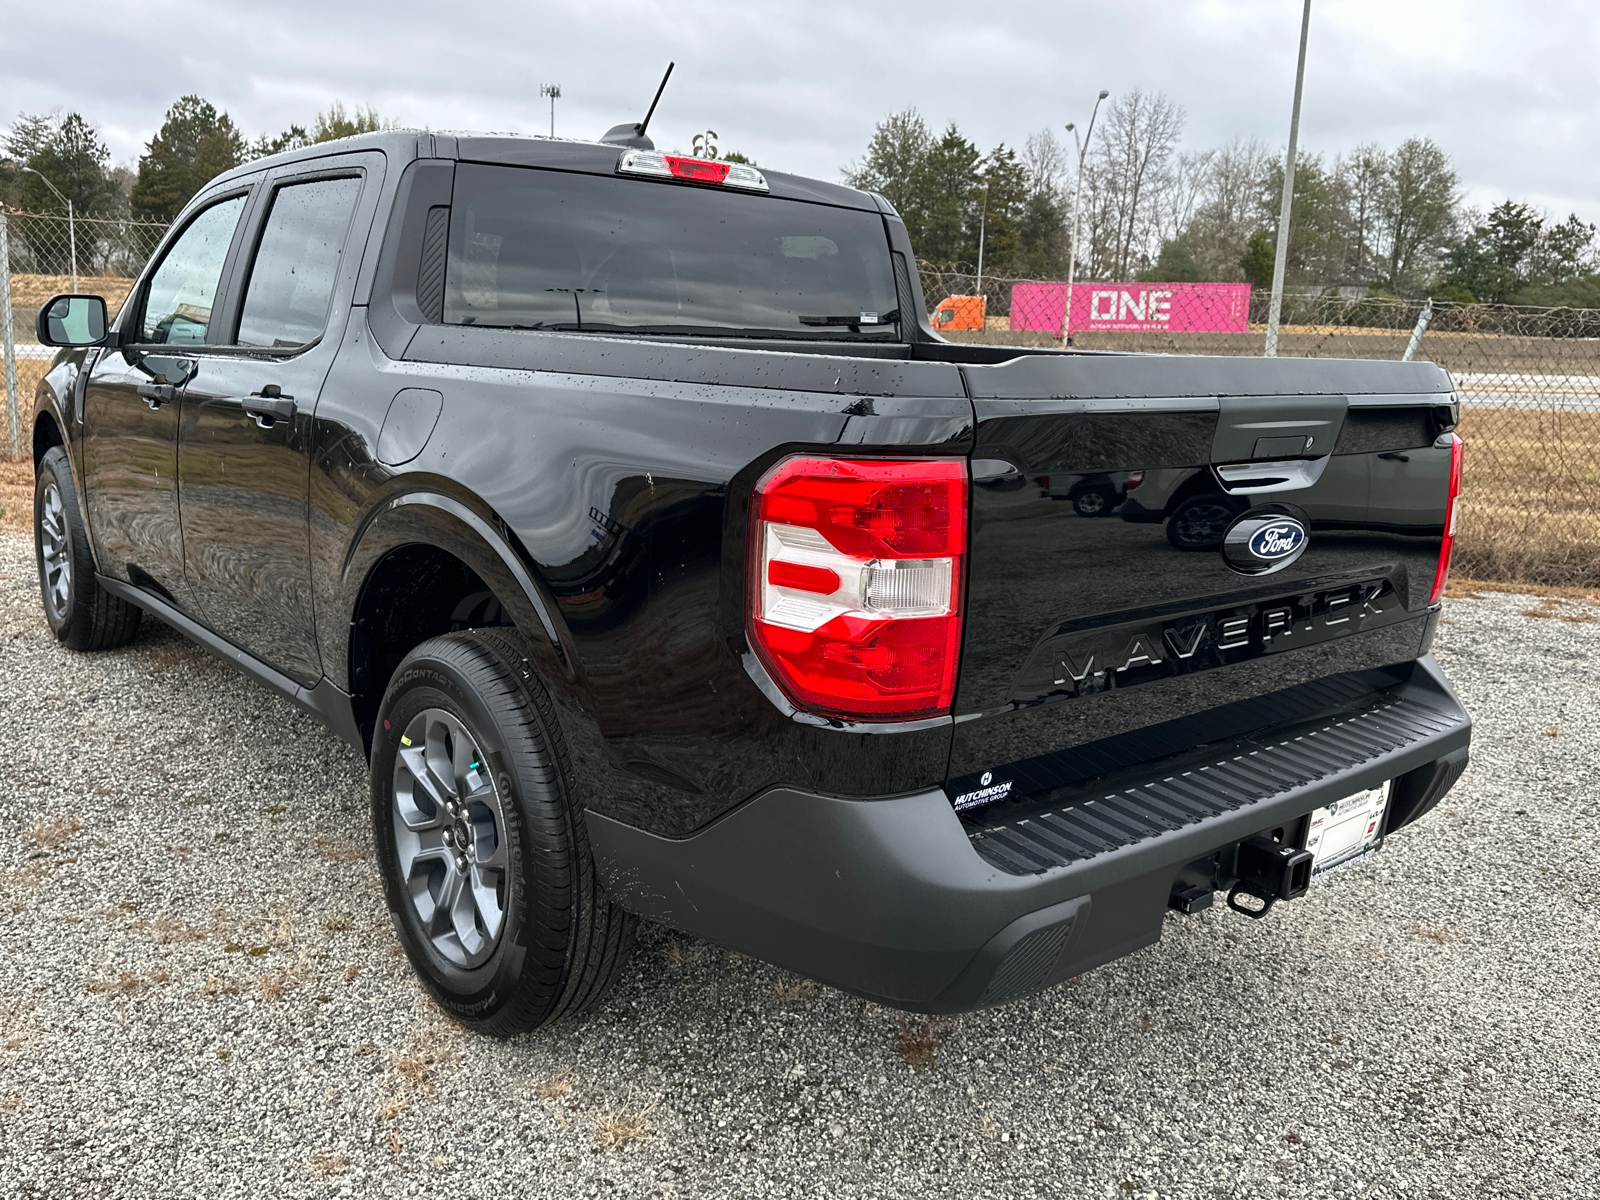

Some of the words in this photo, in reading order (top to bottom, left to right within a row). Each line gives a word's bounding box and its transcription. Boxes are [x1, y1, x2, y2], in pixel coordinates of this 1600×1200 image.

[1090, 290, 1172, 321] ONE
[1259, 527, 1296, 554] Ford
[1053, 586, 1384, 685] MAVERICK
[954, 781, 1013, 806] HUTCHINSON
[954, 797, 989, 811] AUTOMOTIVE
[989, 791, 1008, 802] GROUP
